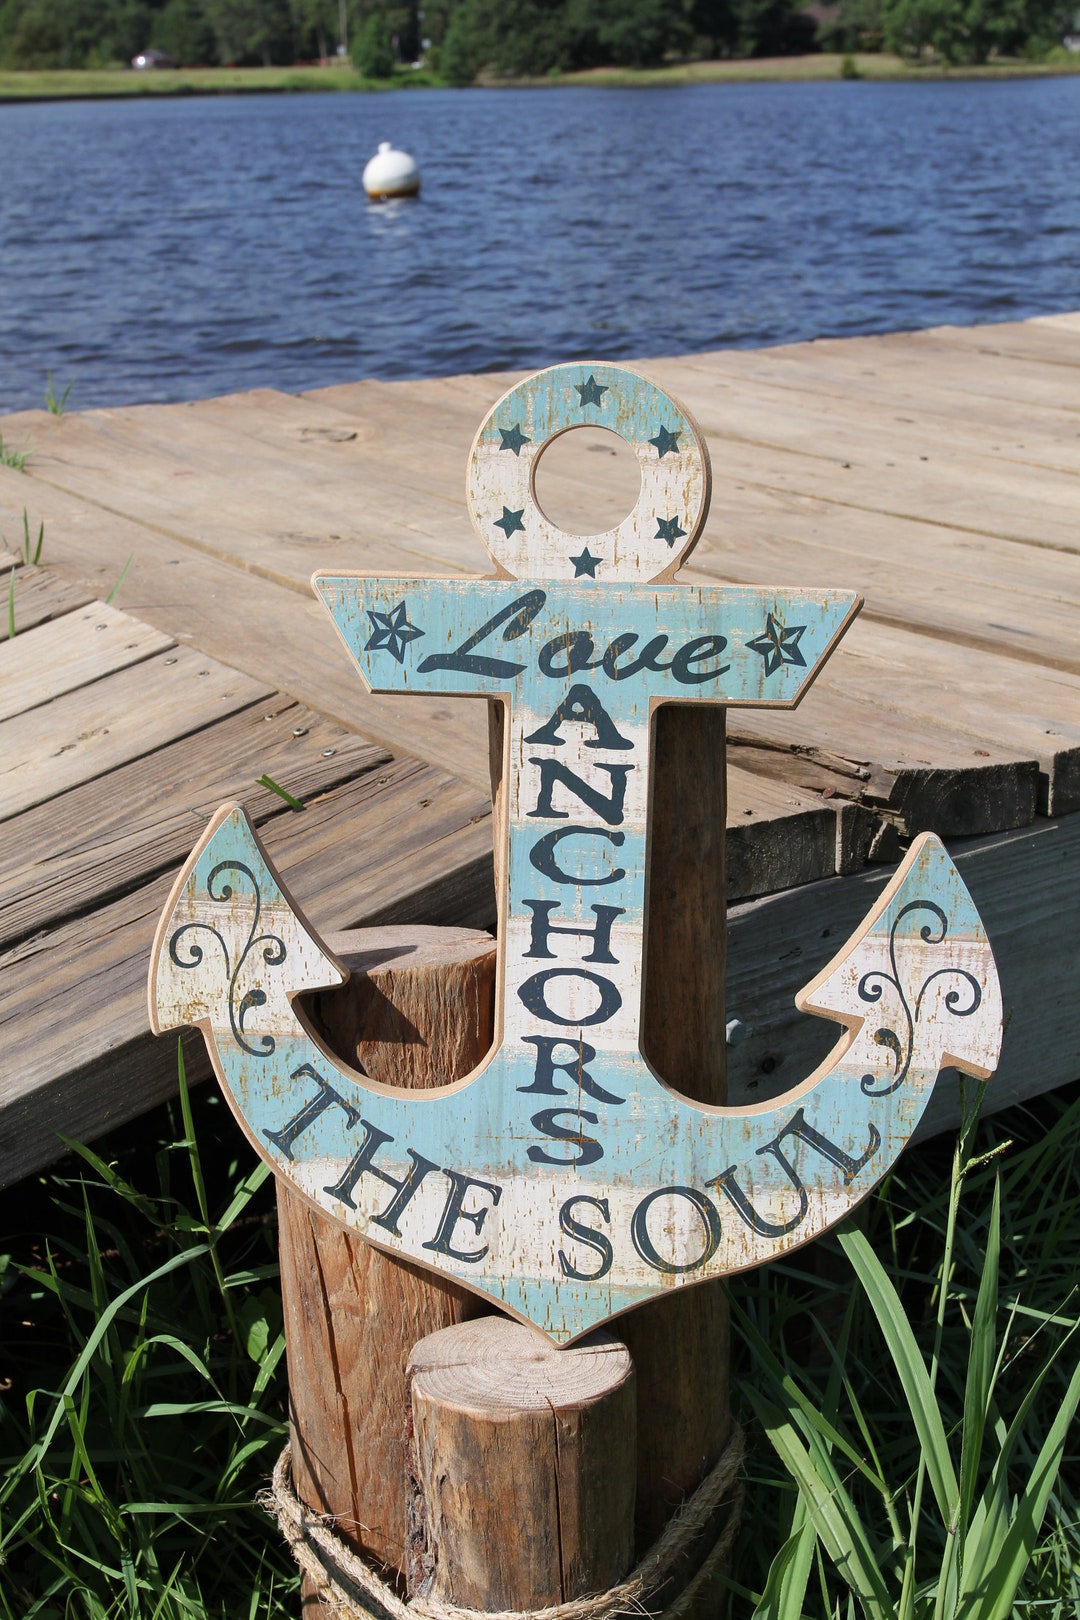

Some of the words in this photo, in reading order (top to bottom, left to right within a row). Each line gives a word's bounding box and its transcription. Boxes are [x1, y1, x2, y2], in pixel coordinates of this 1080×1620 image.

[417, 589, 731, 684] Love
[516, 684, 636, 1167] ANCHORS
[261, 1062, 503, 1263] THE
[558, 1108, 881, 1283] SOUL
